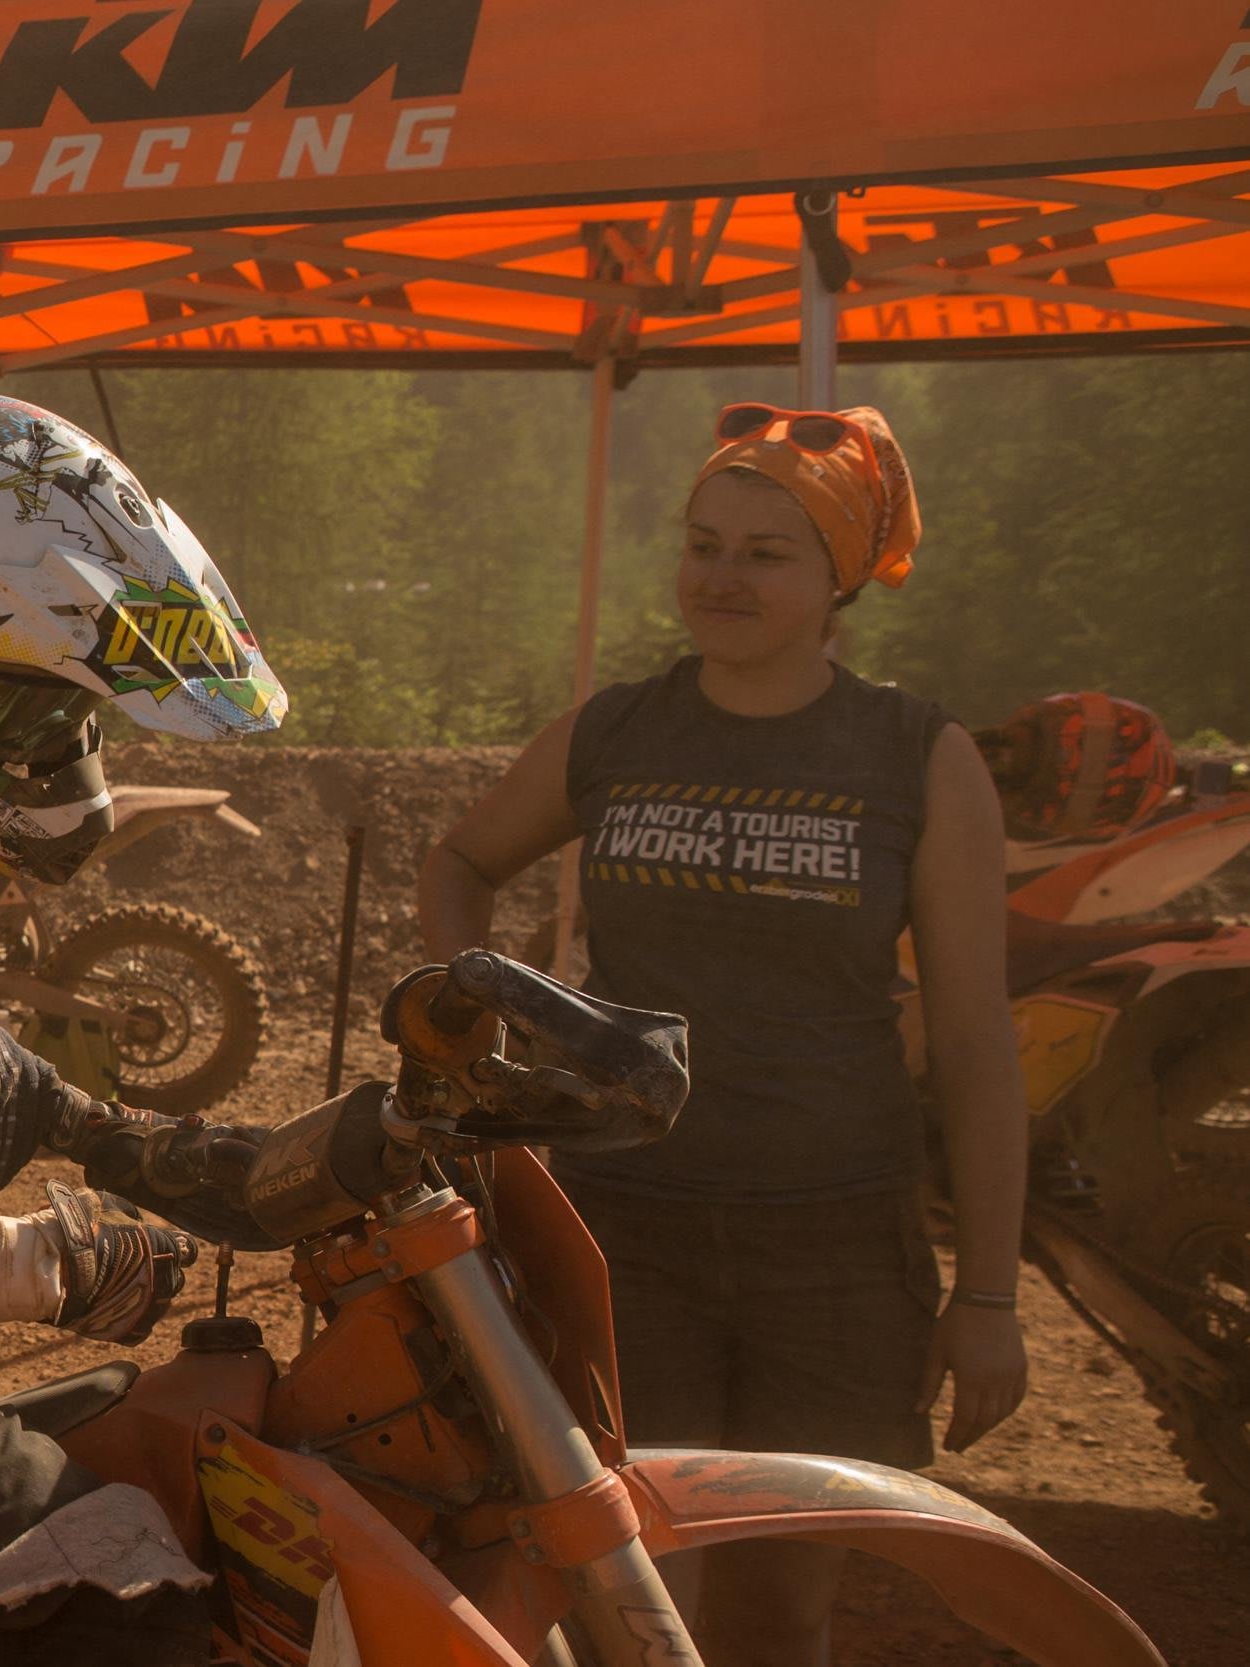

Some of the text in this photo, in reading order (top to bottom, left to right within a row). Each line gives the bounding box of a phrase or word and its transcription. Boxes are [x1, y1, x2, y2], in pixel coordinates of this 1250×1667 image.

[600, 803, 861, 843] I'M NOT A TOURIST
[593, 826, 861, 881] I WORK HERE!
[250, 1163, 317, 1203] NEKEN
